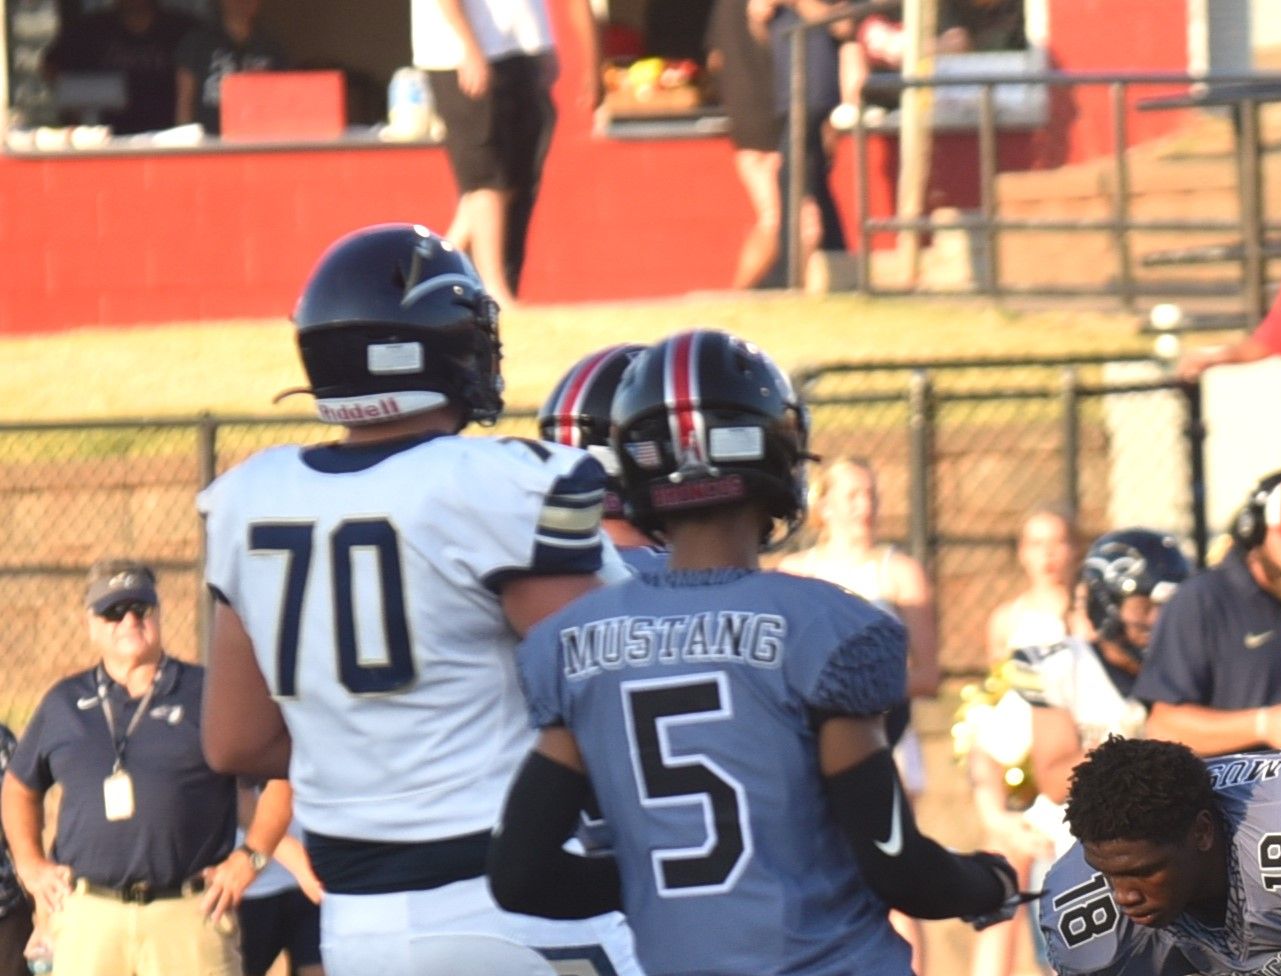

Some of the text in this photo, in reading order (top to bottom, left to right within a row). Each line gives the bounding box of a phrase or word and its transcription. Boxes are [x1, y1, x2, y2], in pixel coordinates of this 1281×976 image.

[246, 515, 419, 700] 70
[560, 611, 787, 680] MUSTANG
[620, 670, 754, 898] 5
[1053, 871, 1119, 949] 18
